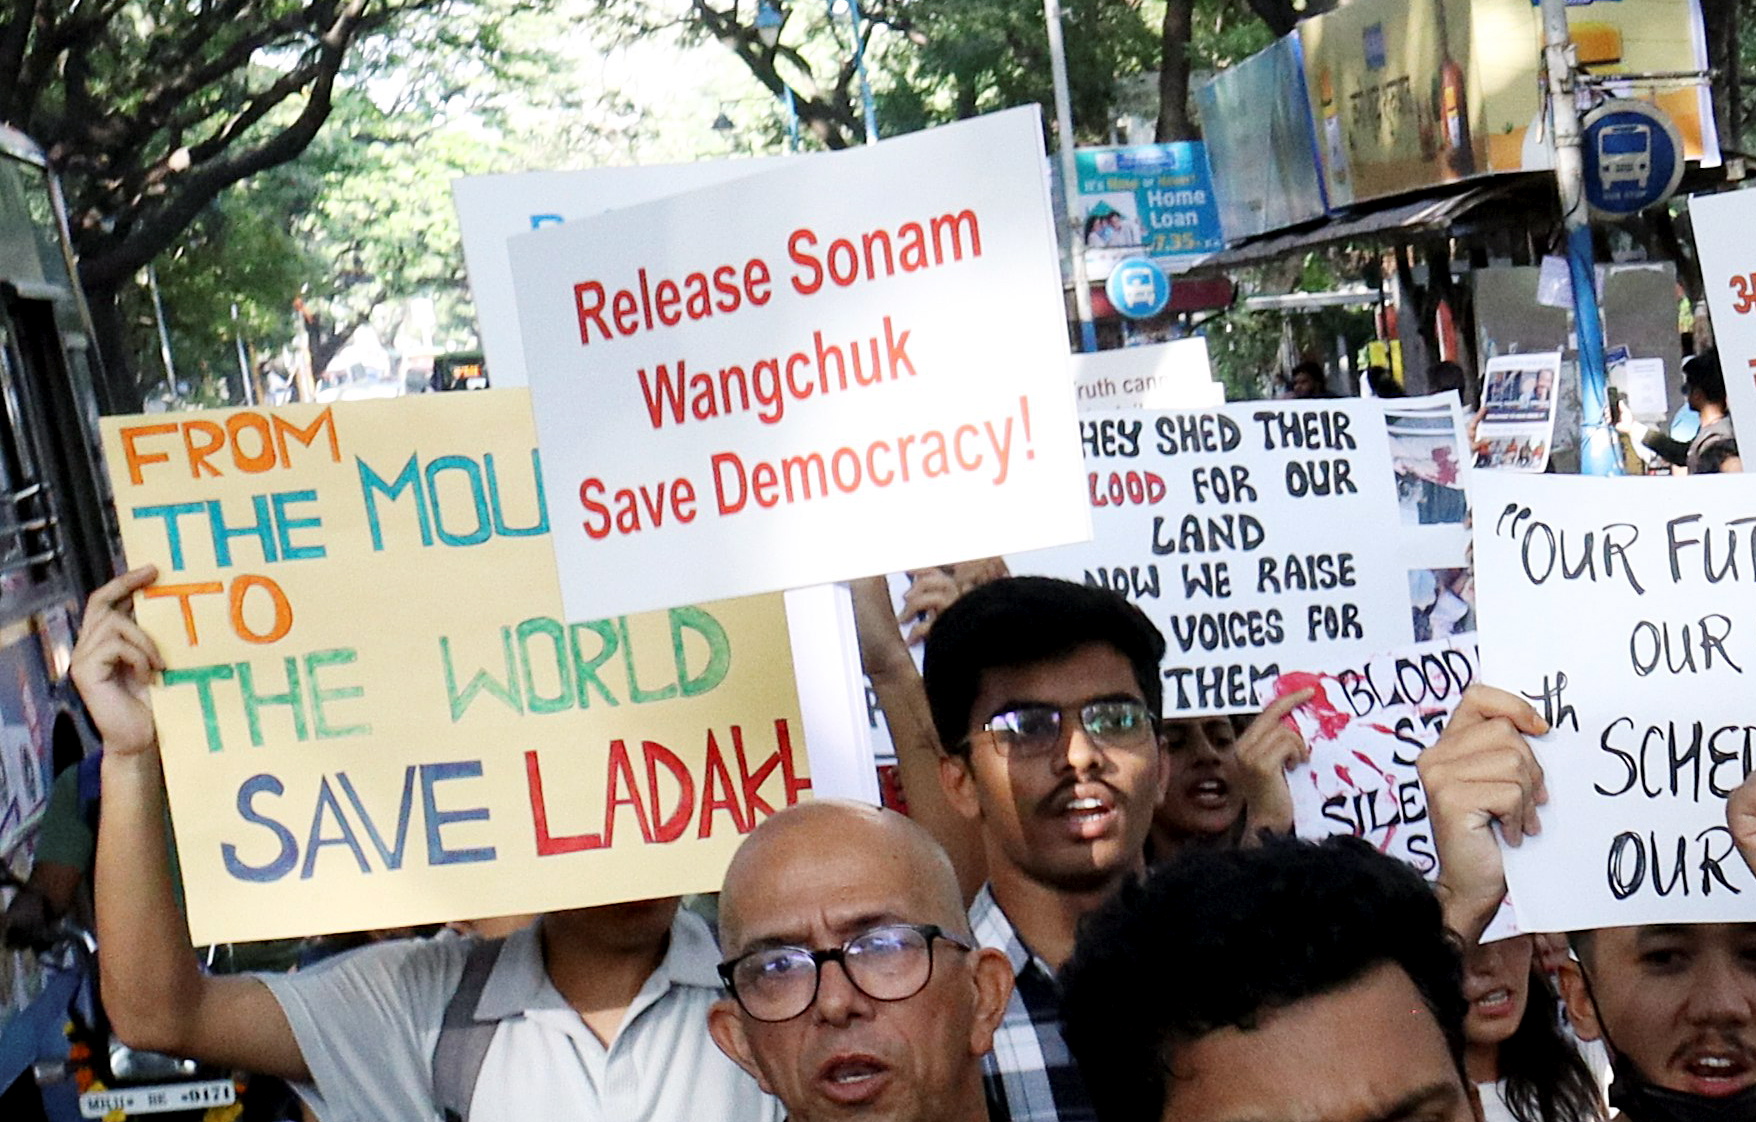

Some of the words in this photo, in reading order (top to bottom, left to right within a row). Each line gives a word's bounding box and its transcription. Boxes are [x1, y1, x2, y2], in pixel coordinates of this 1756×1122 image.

[1147, 189, 1206, 208] Home
[1150, 211, 1199, 229] Loan
[572, 256, 772, 346] Release
[787, 207, 983, 296] Sonam
[637, 316, 918, 430] Wangchuk
[1075, 376, 1116, 400] ruth
[118, 404, 342, 486] FROM
[1079, 418, 1143, 459] HEY
[1155, 412, 1242, 456] SHED
[1252, 410, 1357, 450] THEIR
[578, 476, 698, 541] Save
[710, 395, 1037, 518] Democracy!
[1088, 470, 1167, 507] LOOD
[1192, 465, 1258, 504] FOR
[1285, 458, 1358, 498] OUR
[132, 489, 329, 571] THE
[354, 446, 551, 554] MOU
[1151, 513, 1265, 555] LAND
[1181, 562, 1232, 599] WE
[1257, 553, 1357, 594] RAISE
[142, 573, 294, 647] TO
[1170, 608, 1284, 653] VOICES
[1307, 603, 1364, 641] FOR
[1629, 613, 1743, 677] OUR
[163, 647, 373, 754] THE
[439, 603, 733, 723] WORLD
[1337, 649, 1473, 718] BLOOD
[1520, 670, 1580, 733] th
[220, 759, 497, 884] SAVE
[1321, 780, 1428, 837] SILE
[1606, 826, 1742, 901] OUR
